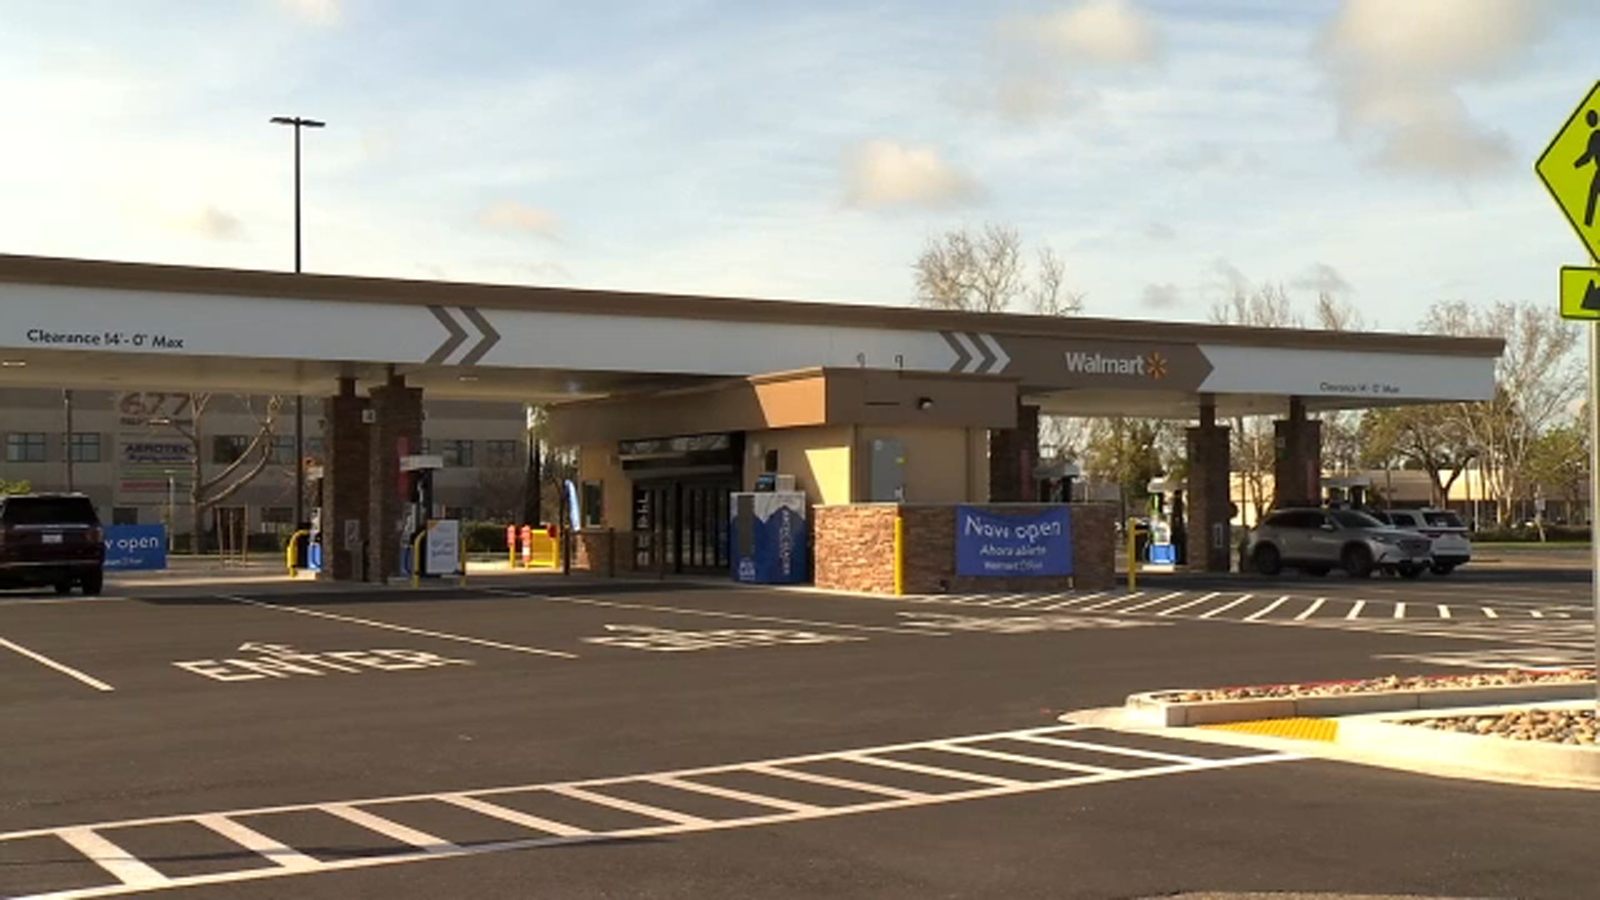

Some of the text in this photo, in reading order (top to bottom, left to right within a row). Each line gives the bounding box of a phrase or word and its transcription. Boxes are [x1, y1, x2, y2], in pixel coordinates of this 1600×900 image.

[26, 329, 101, 346] Clearance
[152, 335, 184, 349] Max
[1065, 352, 1145, 375] Walmart
[965, 514, 1061, 543] Now open
[117, 537, 159, 554] open
[171, 649, 471, 682] ENTER
